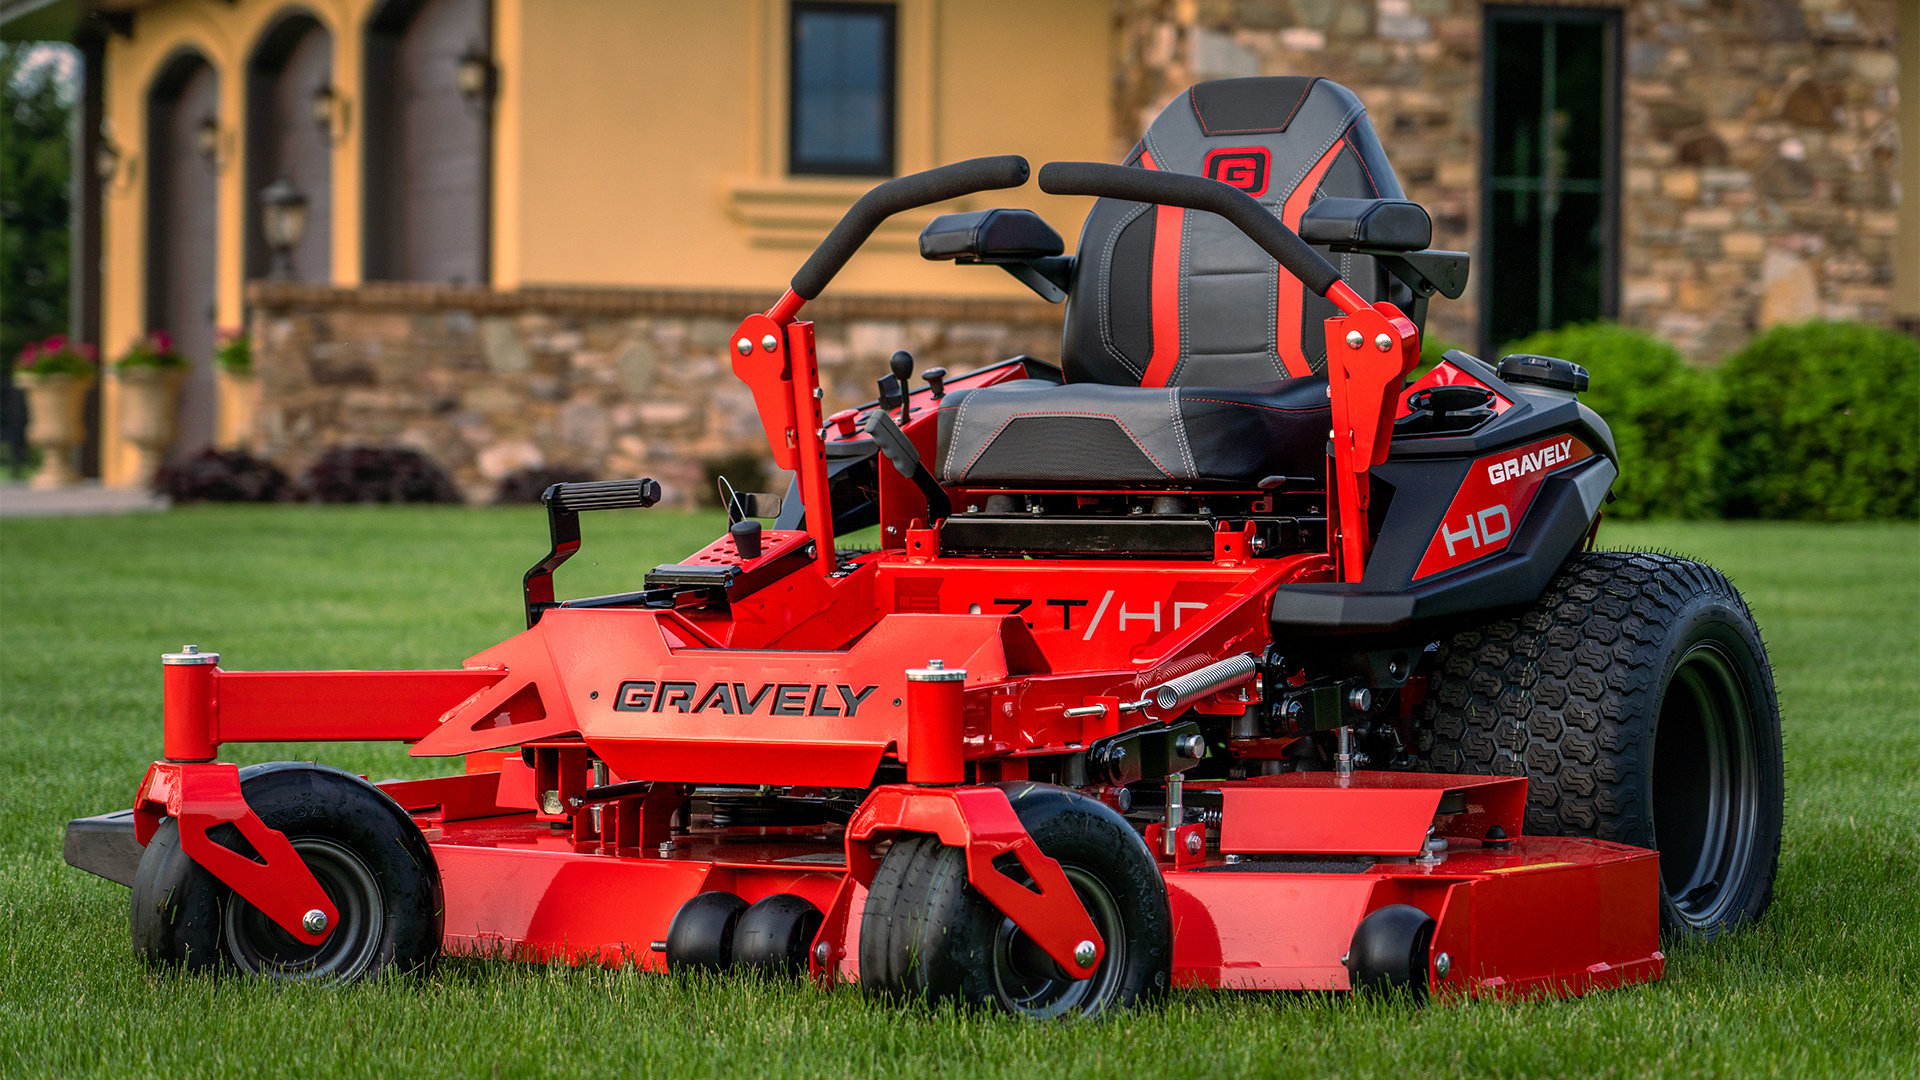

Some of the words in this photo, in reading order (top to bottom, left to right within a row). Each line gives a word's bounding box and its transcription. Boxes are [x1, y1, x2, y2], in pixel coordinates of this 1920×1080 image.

[1209, 153, 1265, 192] G
[1487, 438, 1572, 485] GRAVELY
[1441, 503, 1511, 557] HD
[612, 680, 880, 718] GRAVELY
